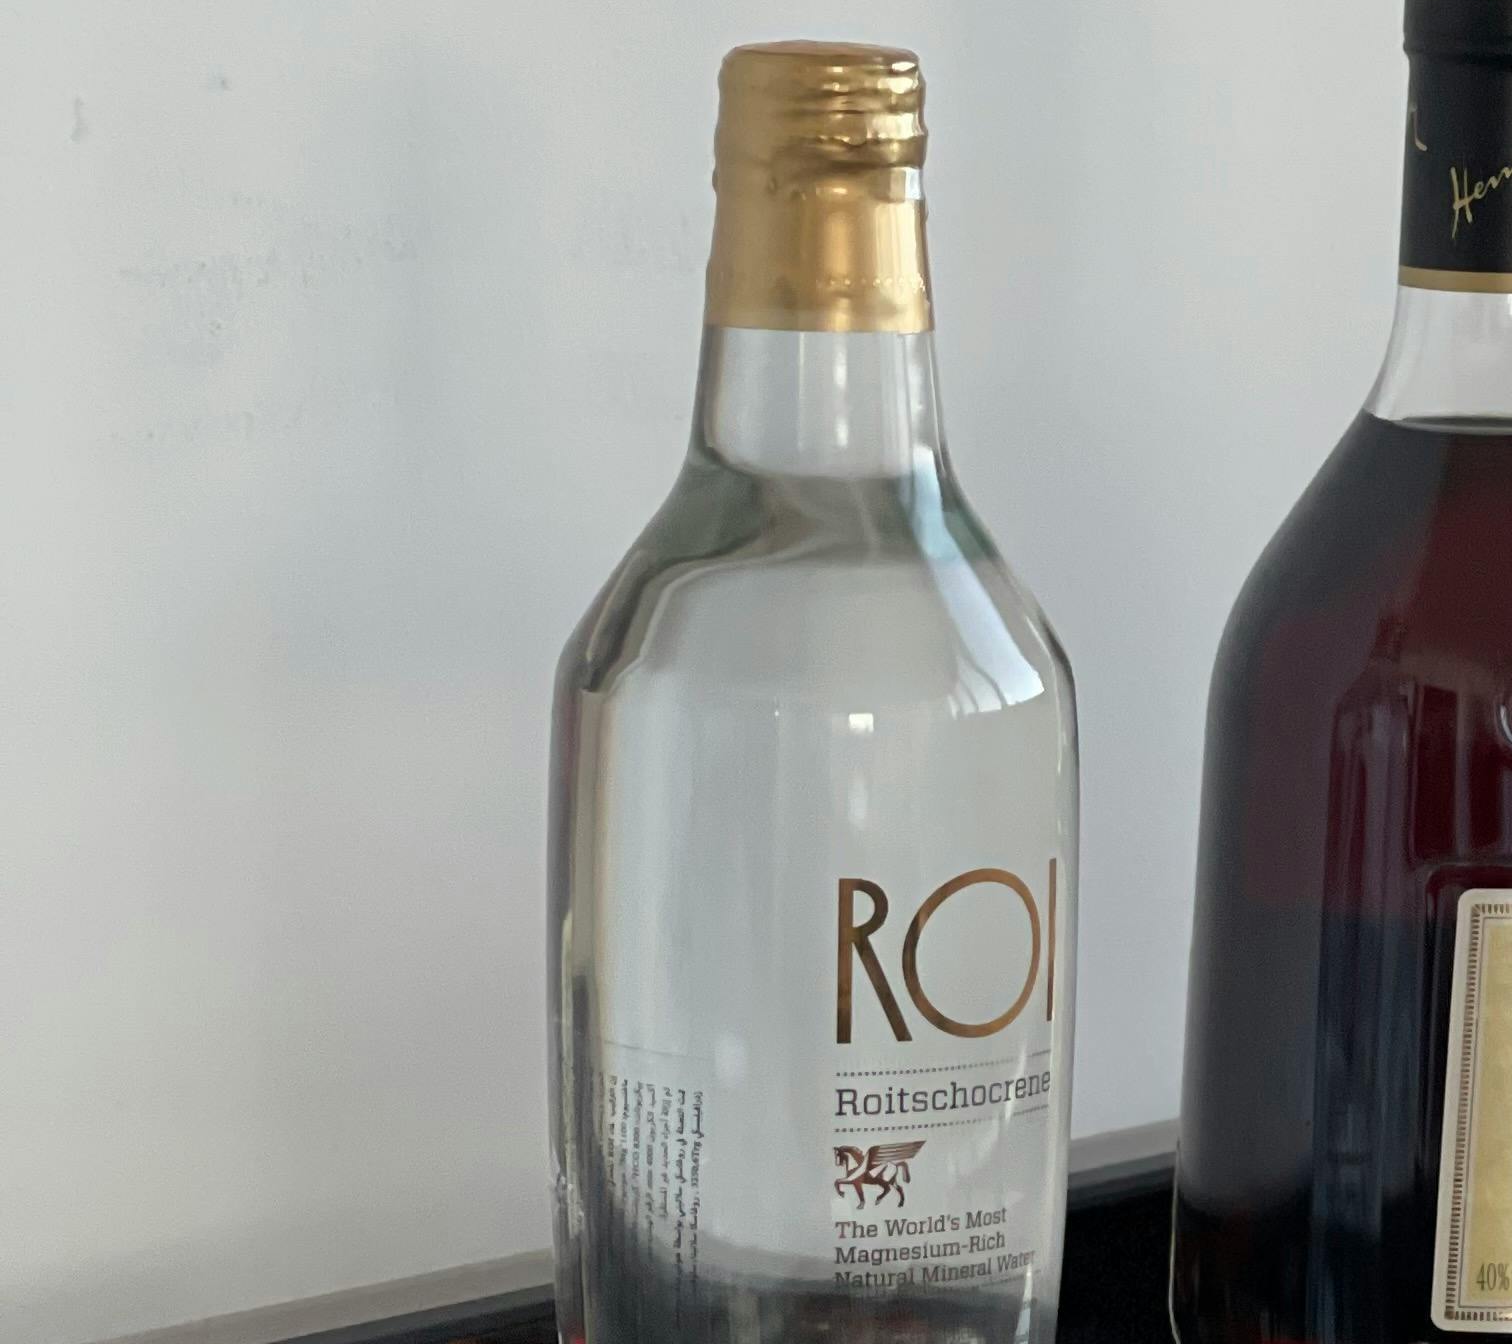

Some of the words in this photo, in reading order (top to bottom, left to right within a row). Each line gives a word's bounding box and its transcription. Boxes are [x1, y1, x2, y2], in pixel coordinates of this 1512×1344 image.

[836, 857, 1057, 1045] ROI
[835, 1070, 1051, 1116] Roitschocrene
[834, 1220, 878, 1240] The
[884, 1213, 961, 1237] World's
[965, 1207, 1007, 1229] Most
[834, 1231, 1006, 1266] Magnesium-Rich
[834, 1267, 914, 1289] Natural
[922, 1257, 992, 1283] Mineral
[997, 1249, 1035, 1272] Water
[1475, 1262, 1510, 1292] 40%
